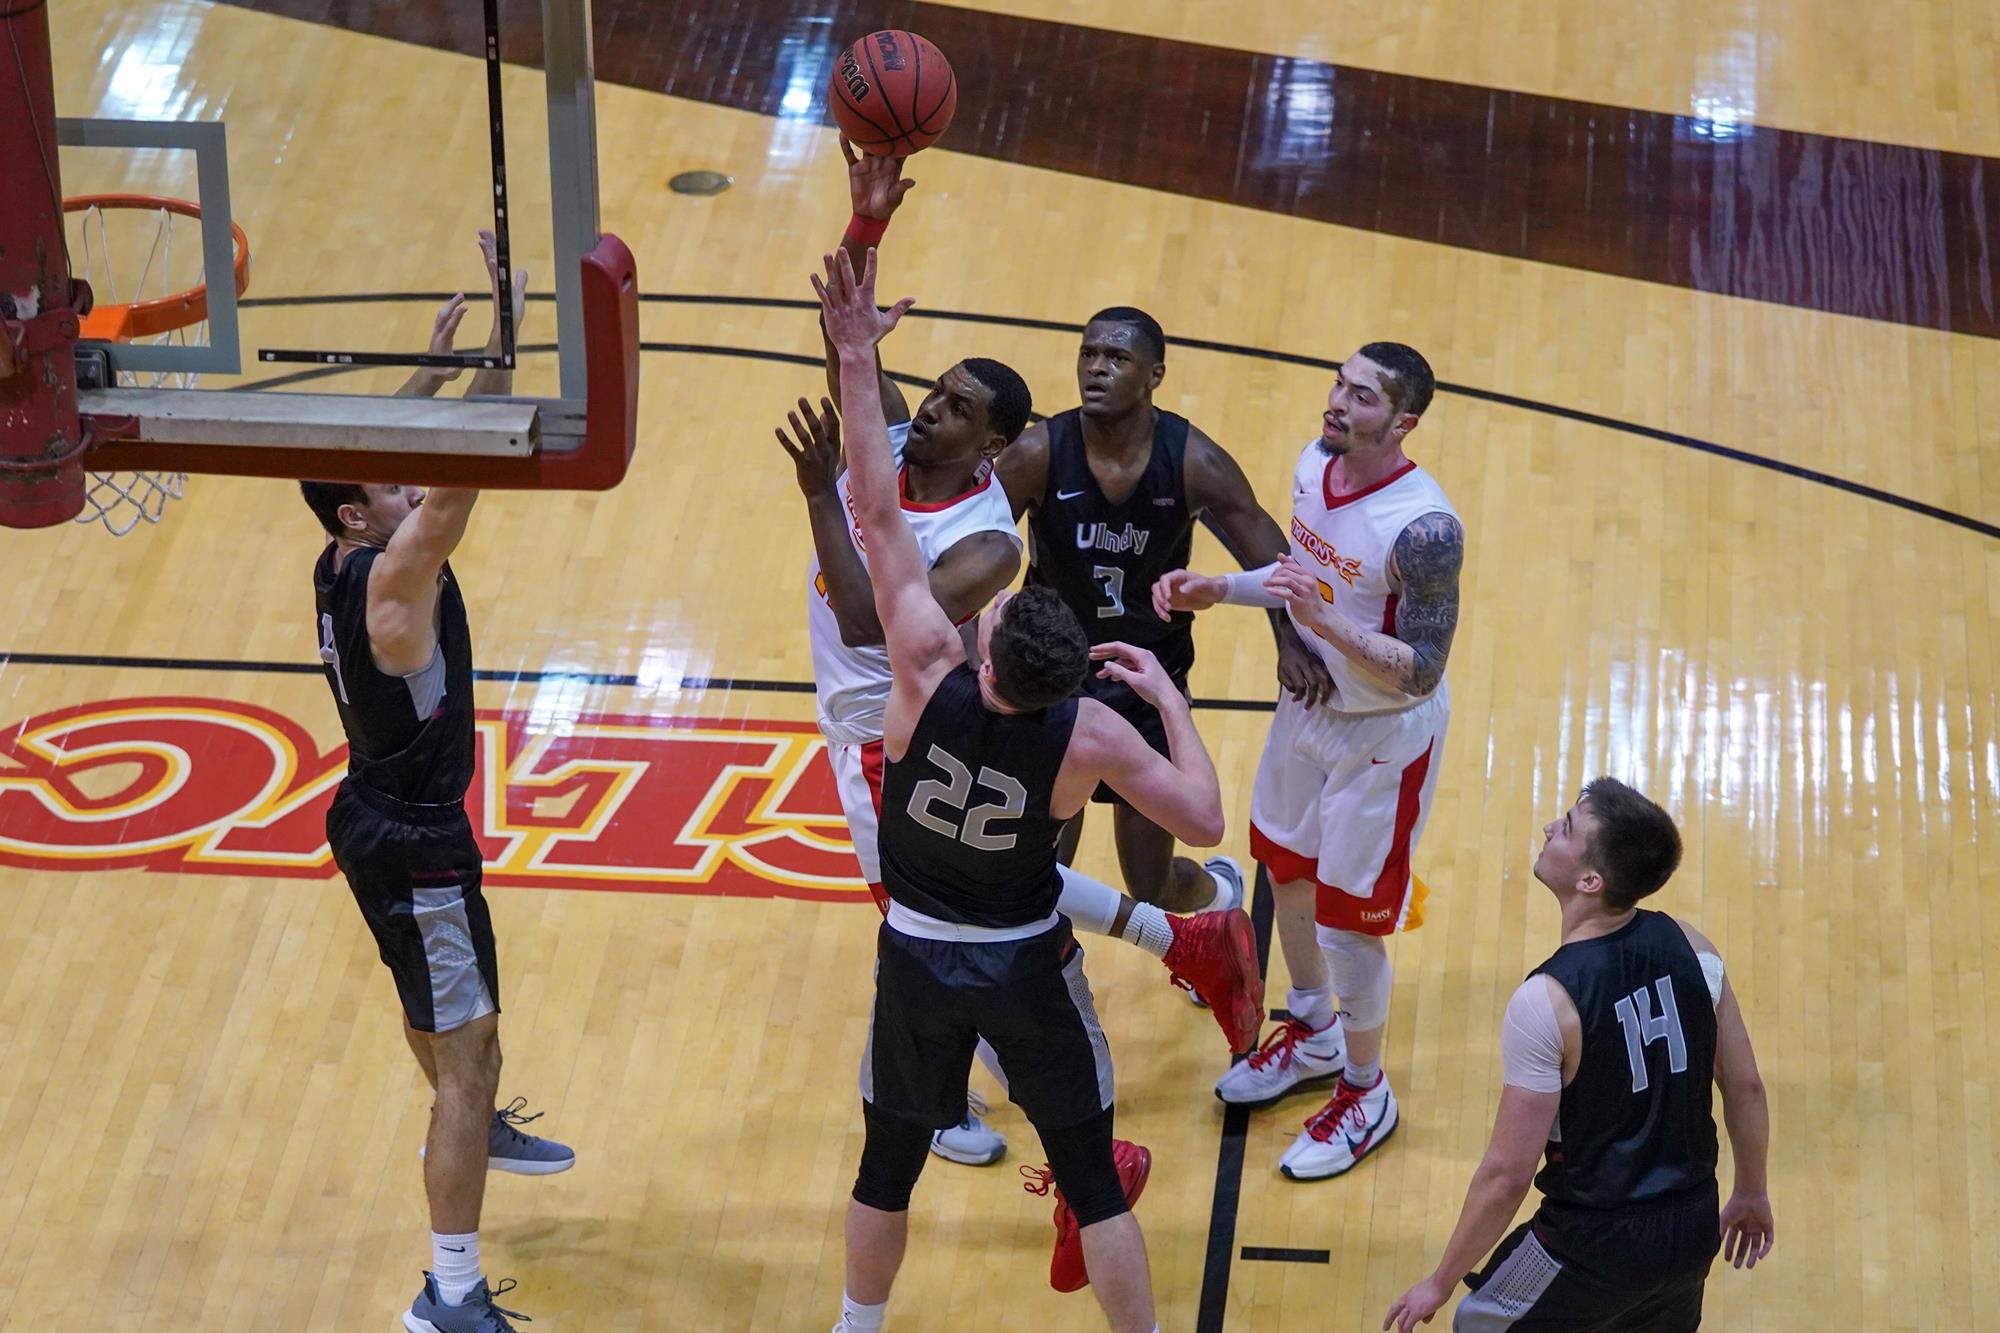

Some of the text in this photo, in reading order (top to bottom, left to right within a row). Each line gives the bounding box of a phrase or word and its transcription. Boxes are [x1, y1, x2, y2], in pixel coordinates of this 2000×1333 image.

[1077, 522, 1149, 555] UIndy
[1093, 565, 1125, 618] 3
[906, 743, 1028, 851] 22
[1614, 974, 1687, 1093] 14
